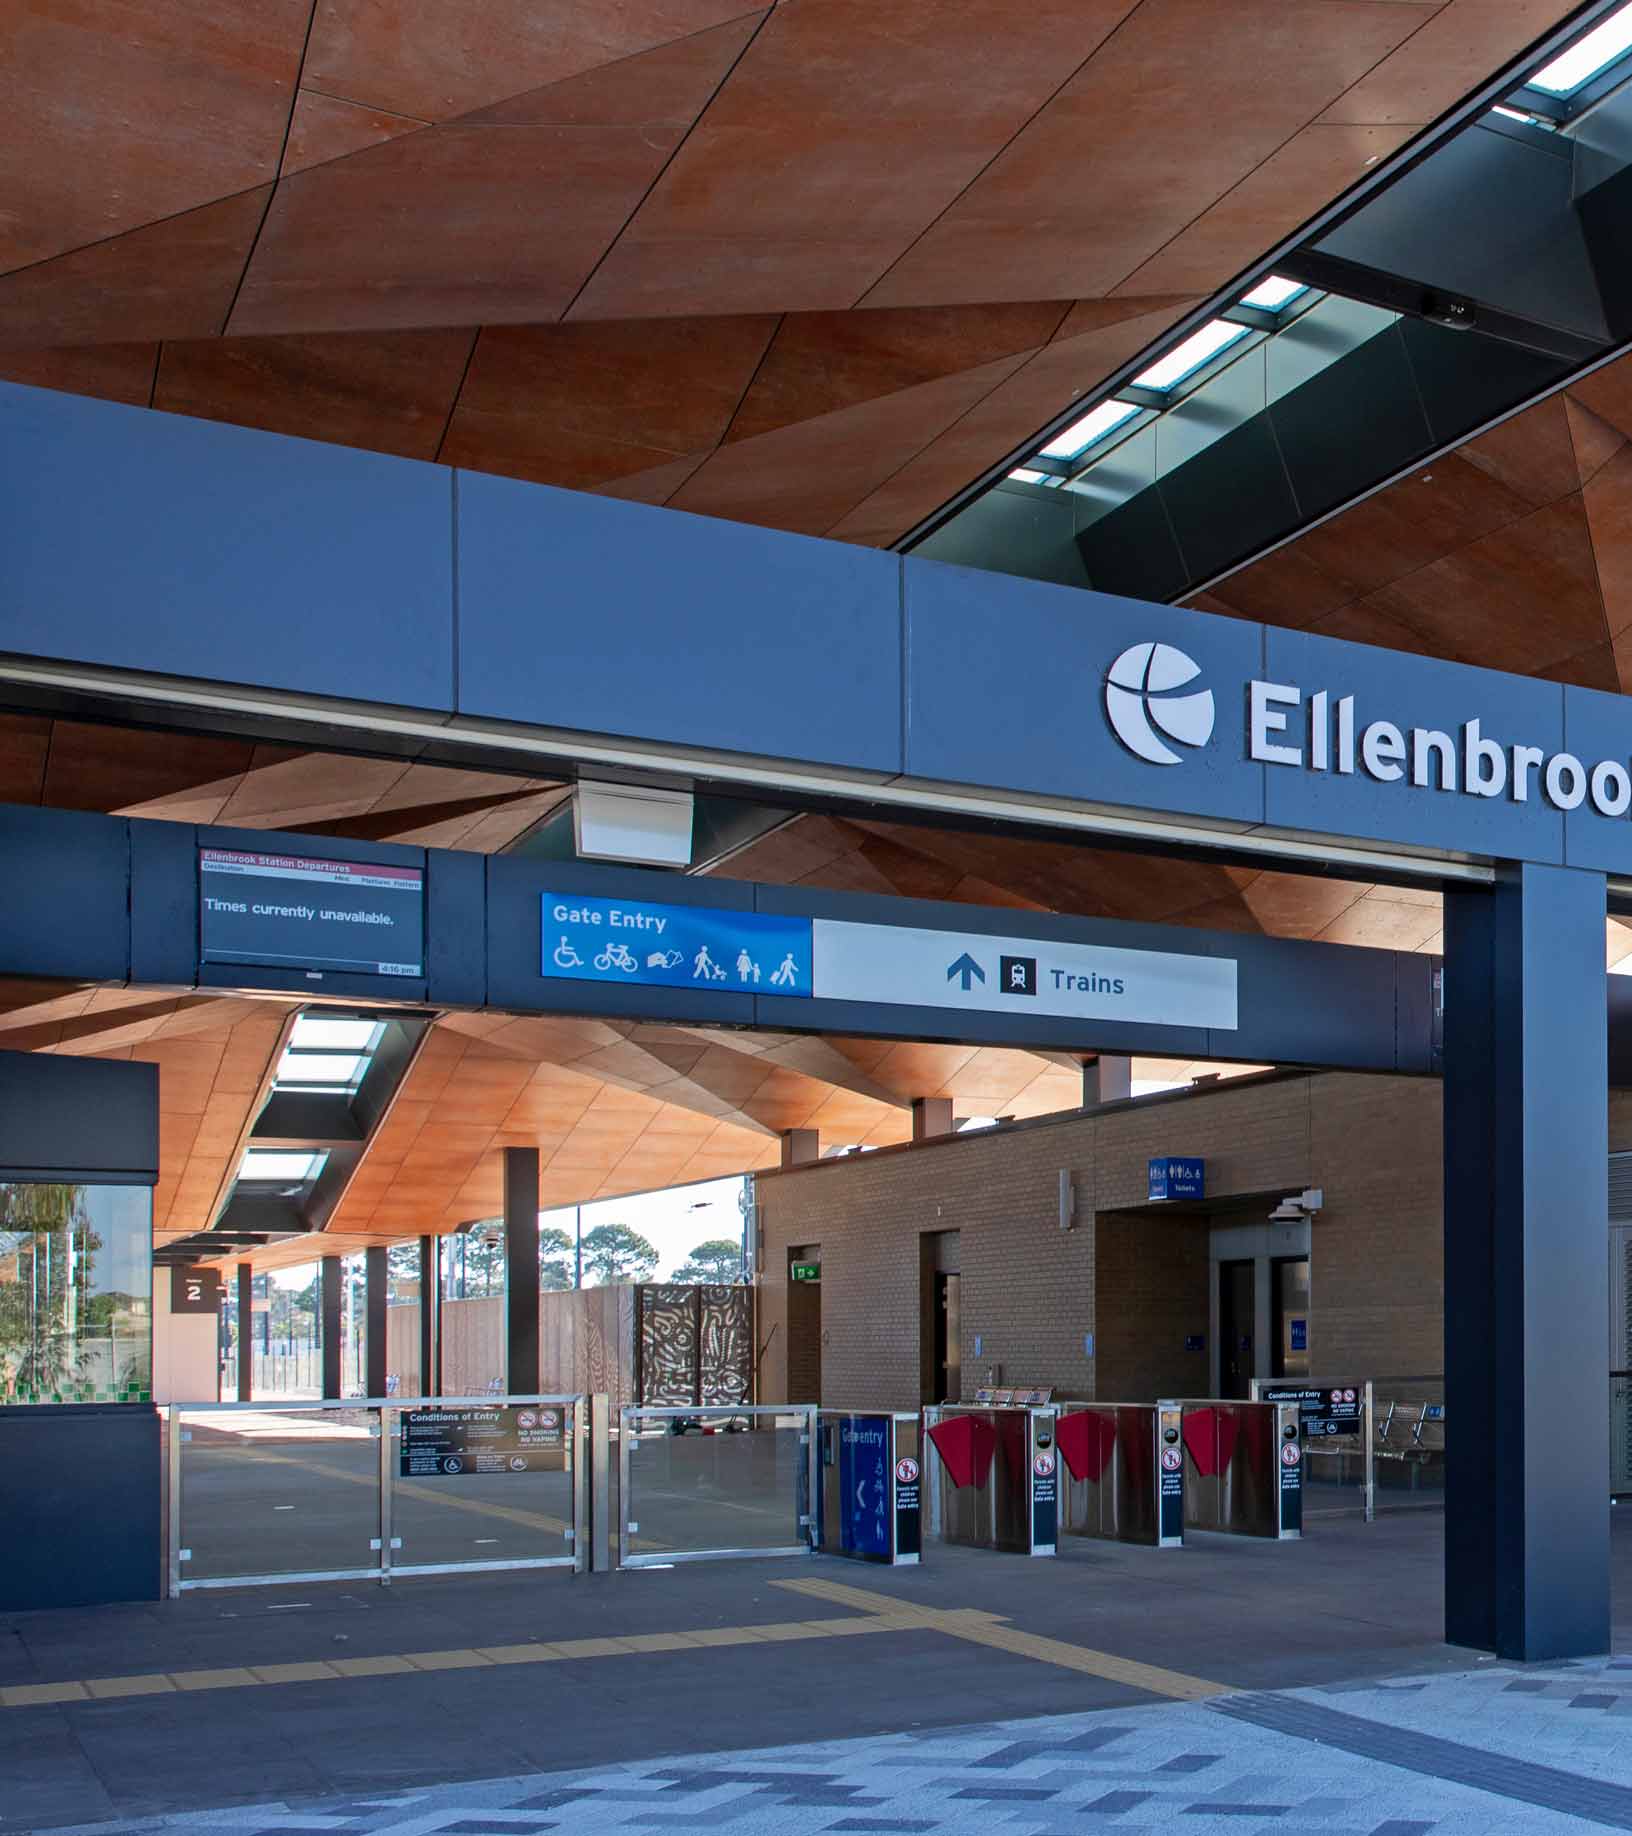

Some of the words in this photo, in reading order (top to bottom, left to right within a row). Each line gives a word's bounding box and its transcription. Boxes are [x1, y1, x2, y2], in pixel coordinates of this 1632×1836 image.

[204, 850, 256, 864] Ellenbrook
[258, 857, 295, 868] Station
[296, 860, 351, 873] Departures
[204, 898, 247, 913] Times
[252, 903, 316, 921] currently
[319, 908, 395, 925] unavailable.
[553, 904, 602, 925] Gate
[609, 909, 667, 935] Entry
[1049, 968, 1125, 995] Trains
[187, 1285, 201, 1300] 2
[1268, 1392, 1297, 1400] Conditions
[1298, 1391, 1305, 1399] of
[1305, 1391, 1321, 1399] Entry
[409, 1412, 459, 1423] Conditions
[461, 1412, 472, 1422] of
[473, 1412, 500, 1422] Entry
[860, 1429, 883, 1448] entry
